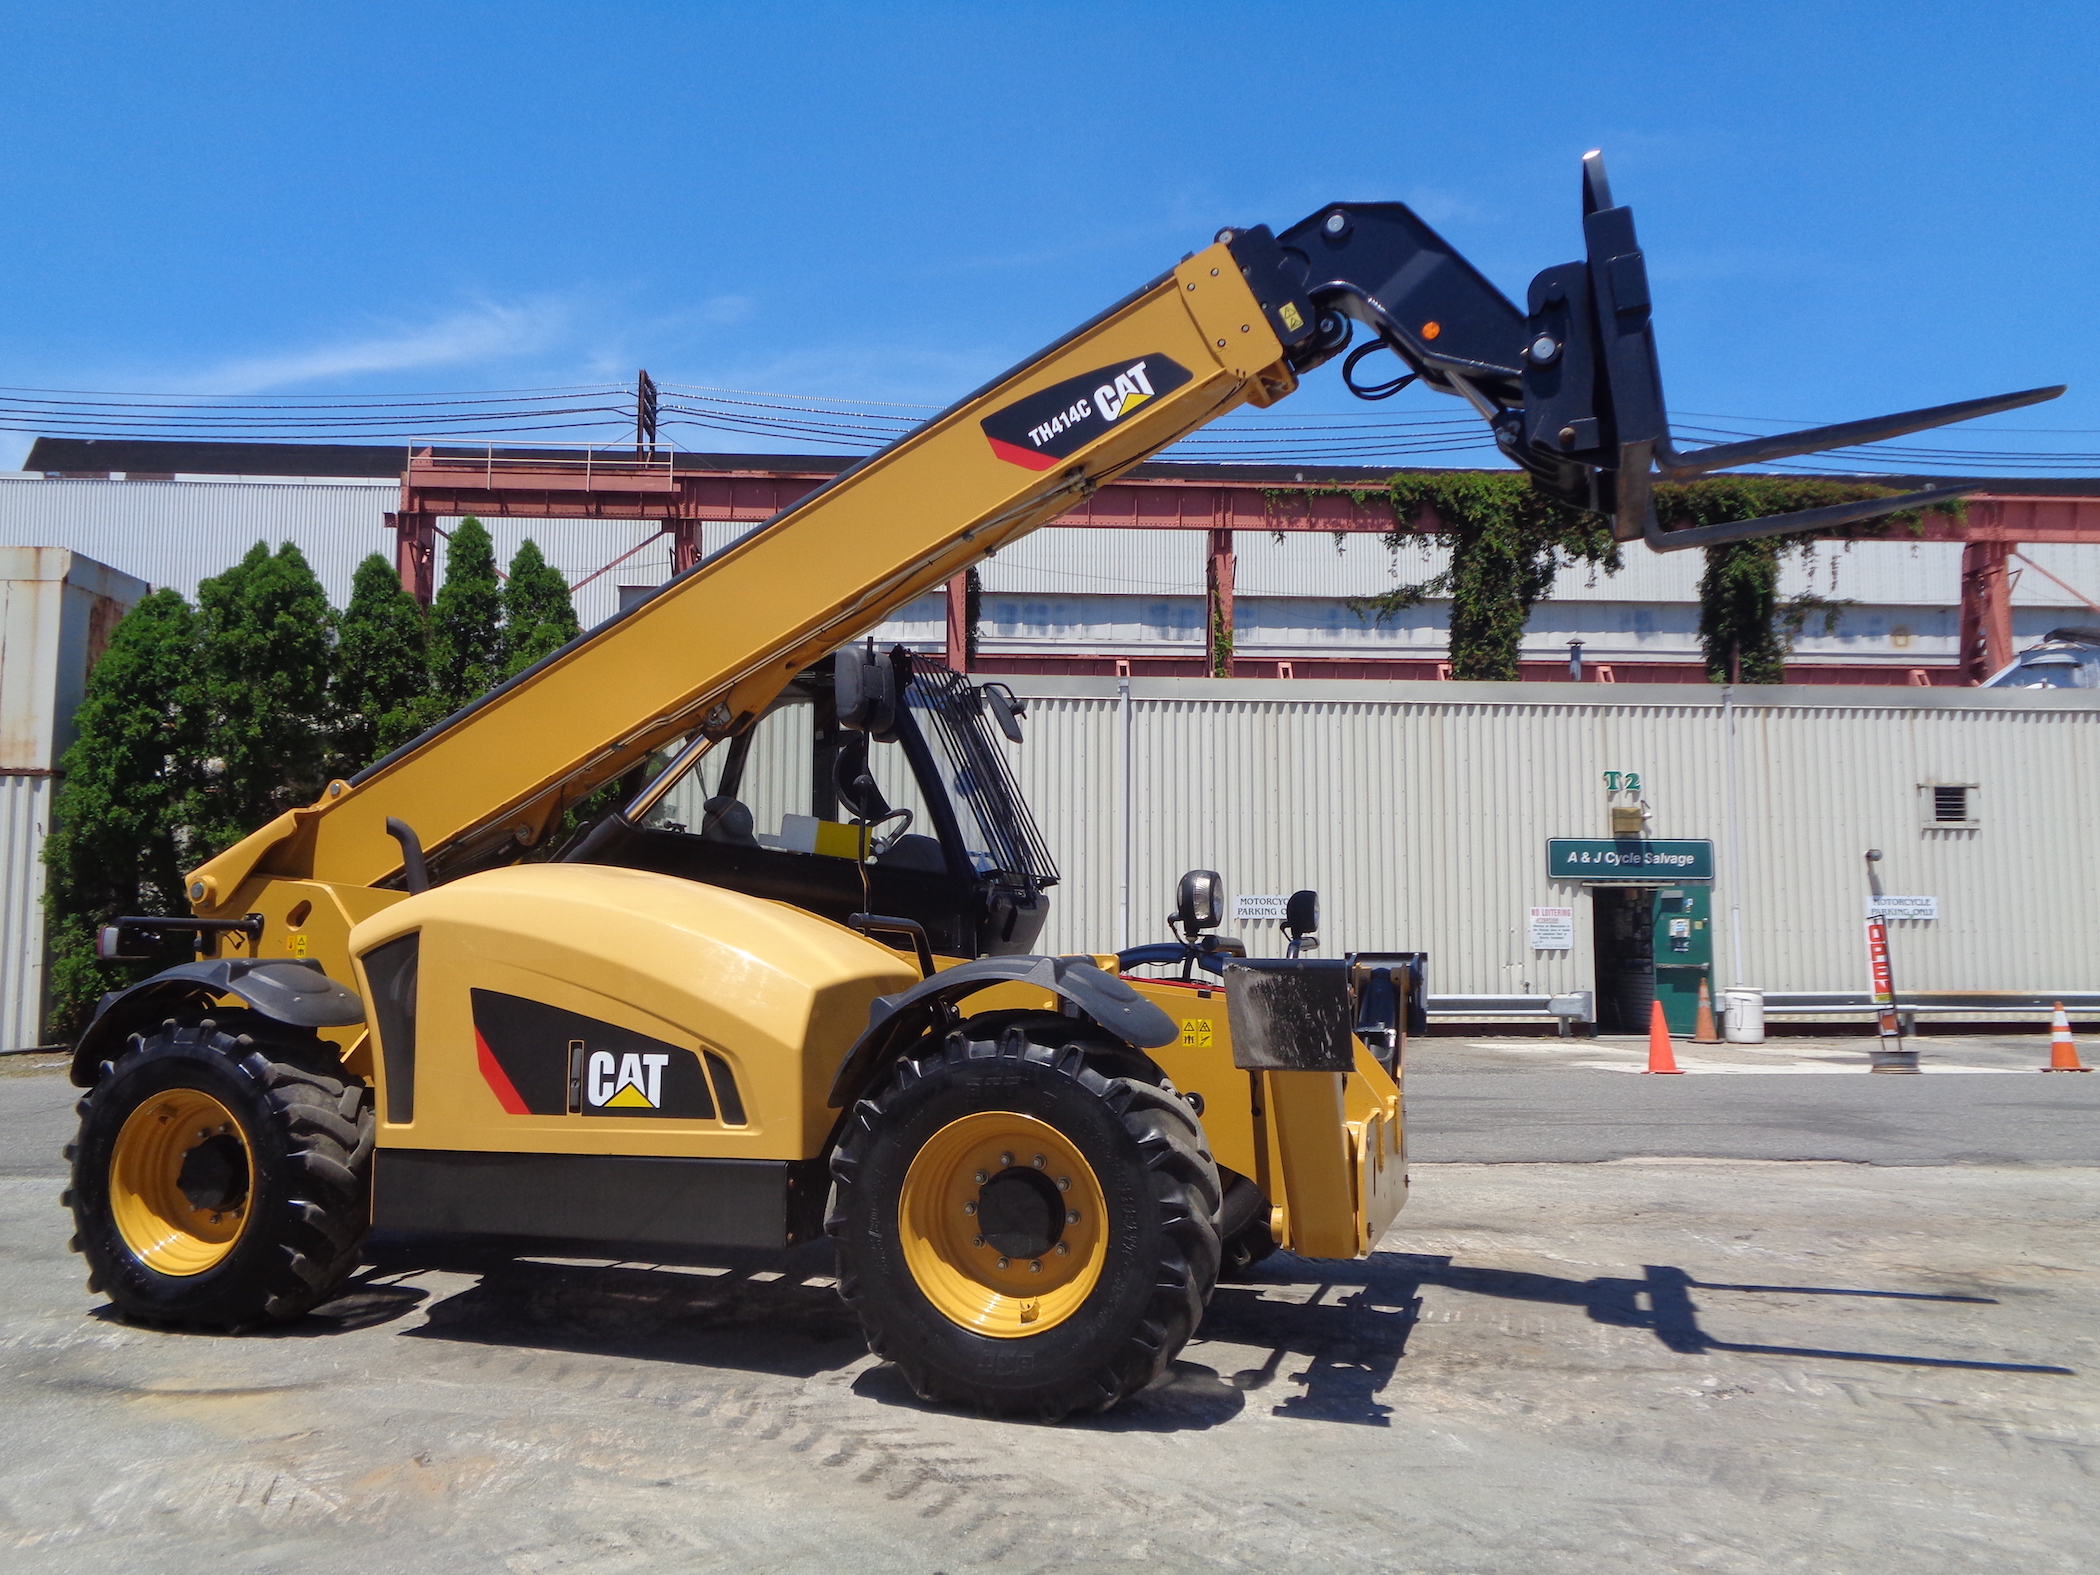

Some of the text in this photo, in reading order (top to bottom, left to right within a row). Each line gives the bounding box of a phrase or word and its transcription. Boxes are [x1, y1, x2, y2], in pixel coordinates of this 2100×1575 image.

[1028, 361, 1156, 448] TH414C CAT
[1567, 851, 1695, 867] A & J Cycle Salvage
[1240, 898, 1289, 906] MOTORCYC
[1873, 898, 1931, 906] MOTORCYCLE
[1237, 907, 1277, 916] PARKING
[1531, 908, 1571, 917] NO LOITERING
[1871, 908, 1935, 916] PARKING ONLY
[1869, 924, 1892, 994] OPEN
[587, 1050, 669, 1109] CAT
